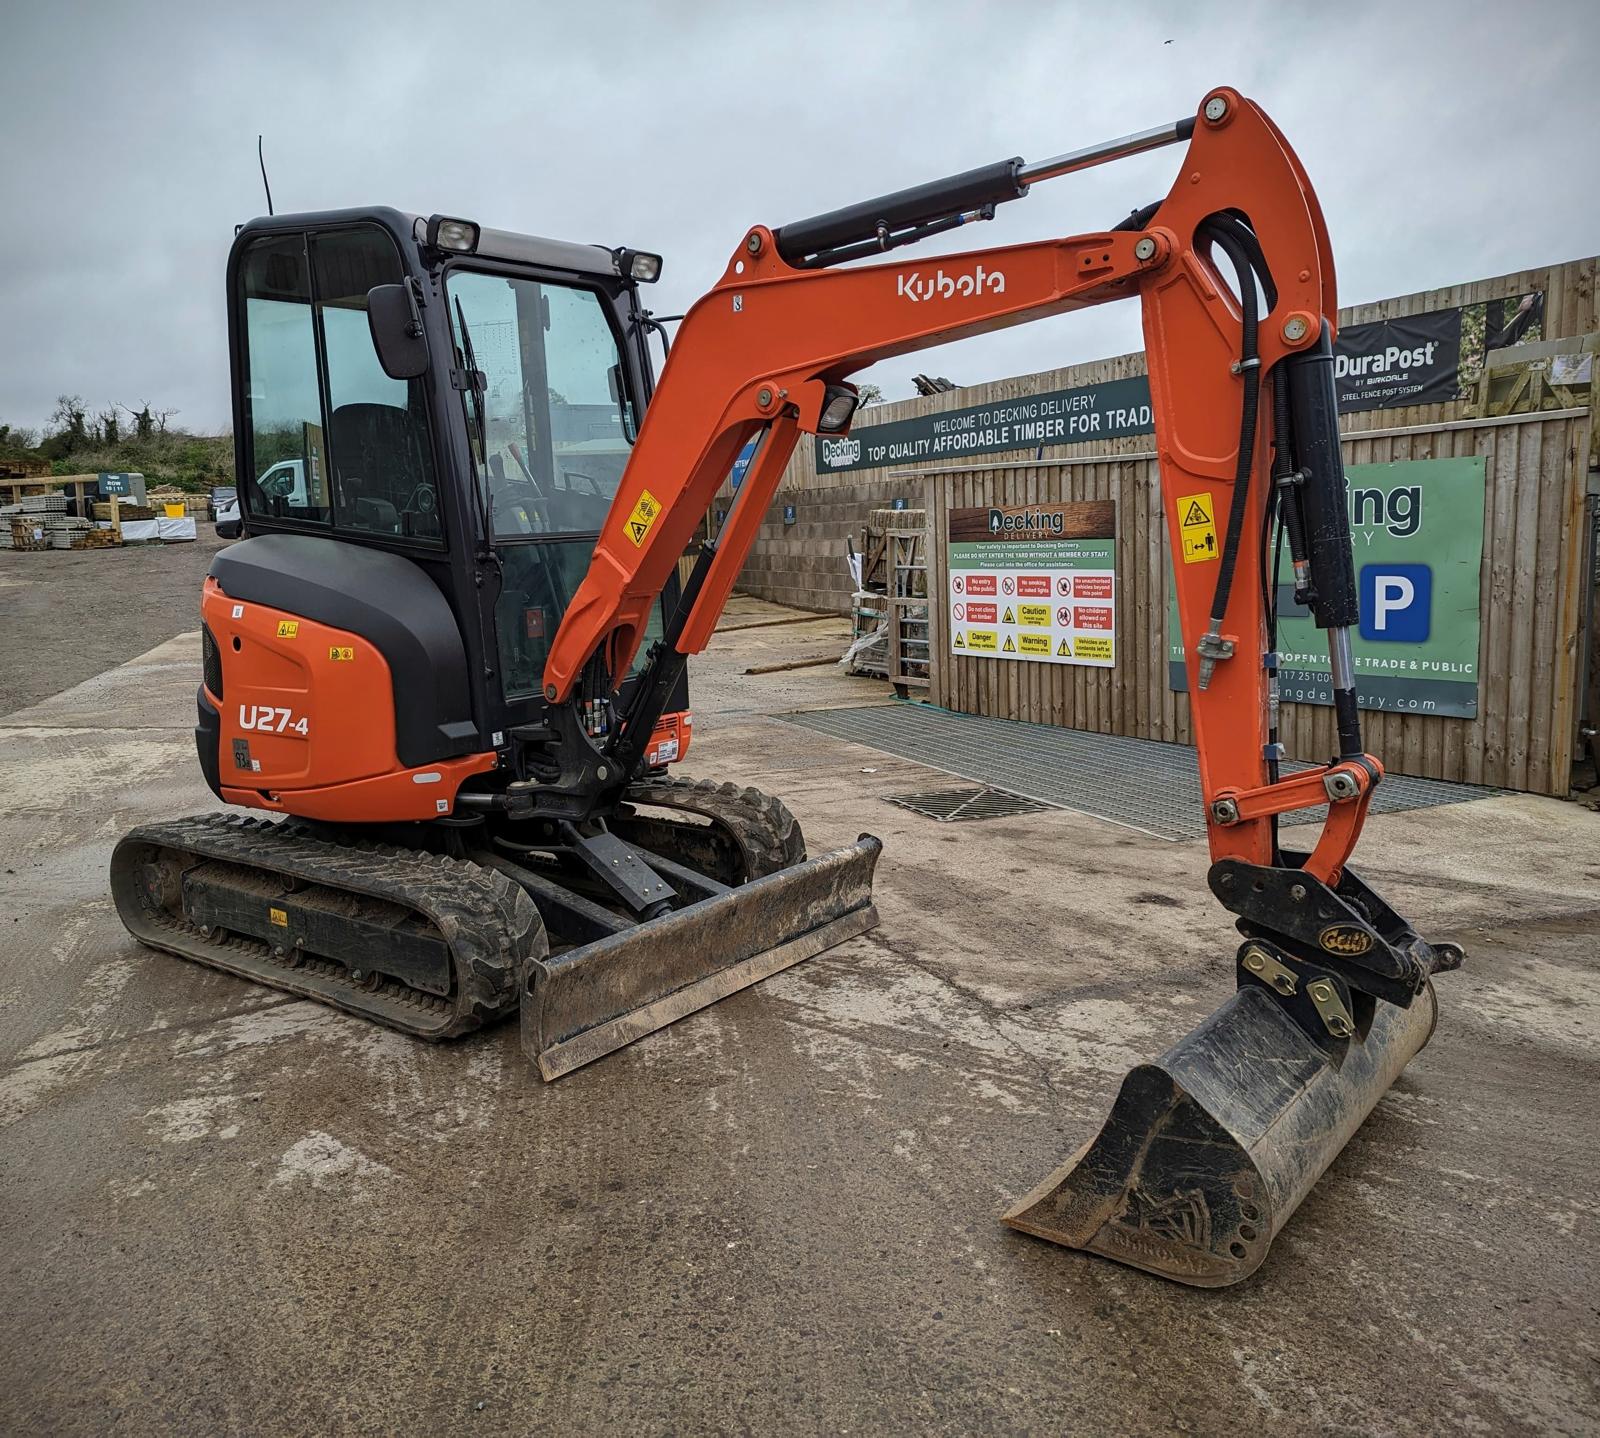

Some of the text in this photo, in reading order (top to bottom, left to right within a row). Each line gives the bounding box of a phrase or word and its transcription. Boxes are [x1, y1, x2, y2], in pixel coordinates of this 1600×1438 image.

[897, 265, 1005, 301] Kubota
[1366, 373, 1409, 385] BIRKDALE
[1342, 384, 1424, 401] STEEL FENCE POST SYSTEM
[933, 394, 1096, 434] WELCOME TO DECKING DELIVERY
[868, 446, 885, 461] TOP
[889, 439, 930, 459] QUALITY
[933, 426, 1009, 453] AFFORDABLE
[1013, 419, 1065, 442] TIMBER
[1070, 412, 1100, 434] FOR
[822, 437, 861, 465] Decking
[988, 507, 1065, 536] Decking
[1003, 531, 1049, 540] DELIVERY
[1022, 607, 1047, 615] Caution
[1375, 576, 1415, 630] P
[972, 633, 992, 642] Danger
[1022, 636, 1048, 647] Warning
[1286, 653, 1317, 664] OPEN
[1365, 657, 1406, 669] TRADE
[1410, 660, 1418, 670] &
[1422, 661, 1474, 673] PUBLIC
[240, 704, 309, 736] U27-4
